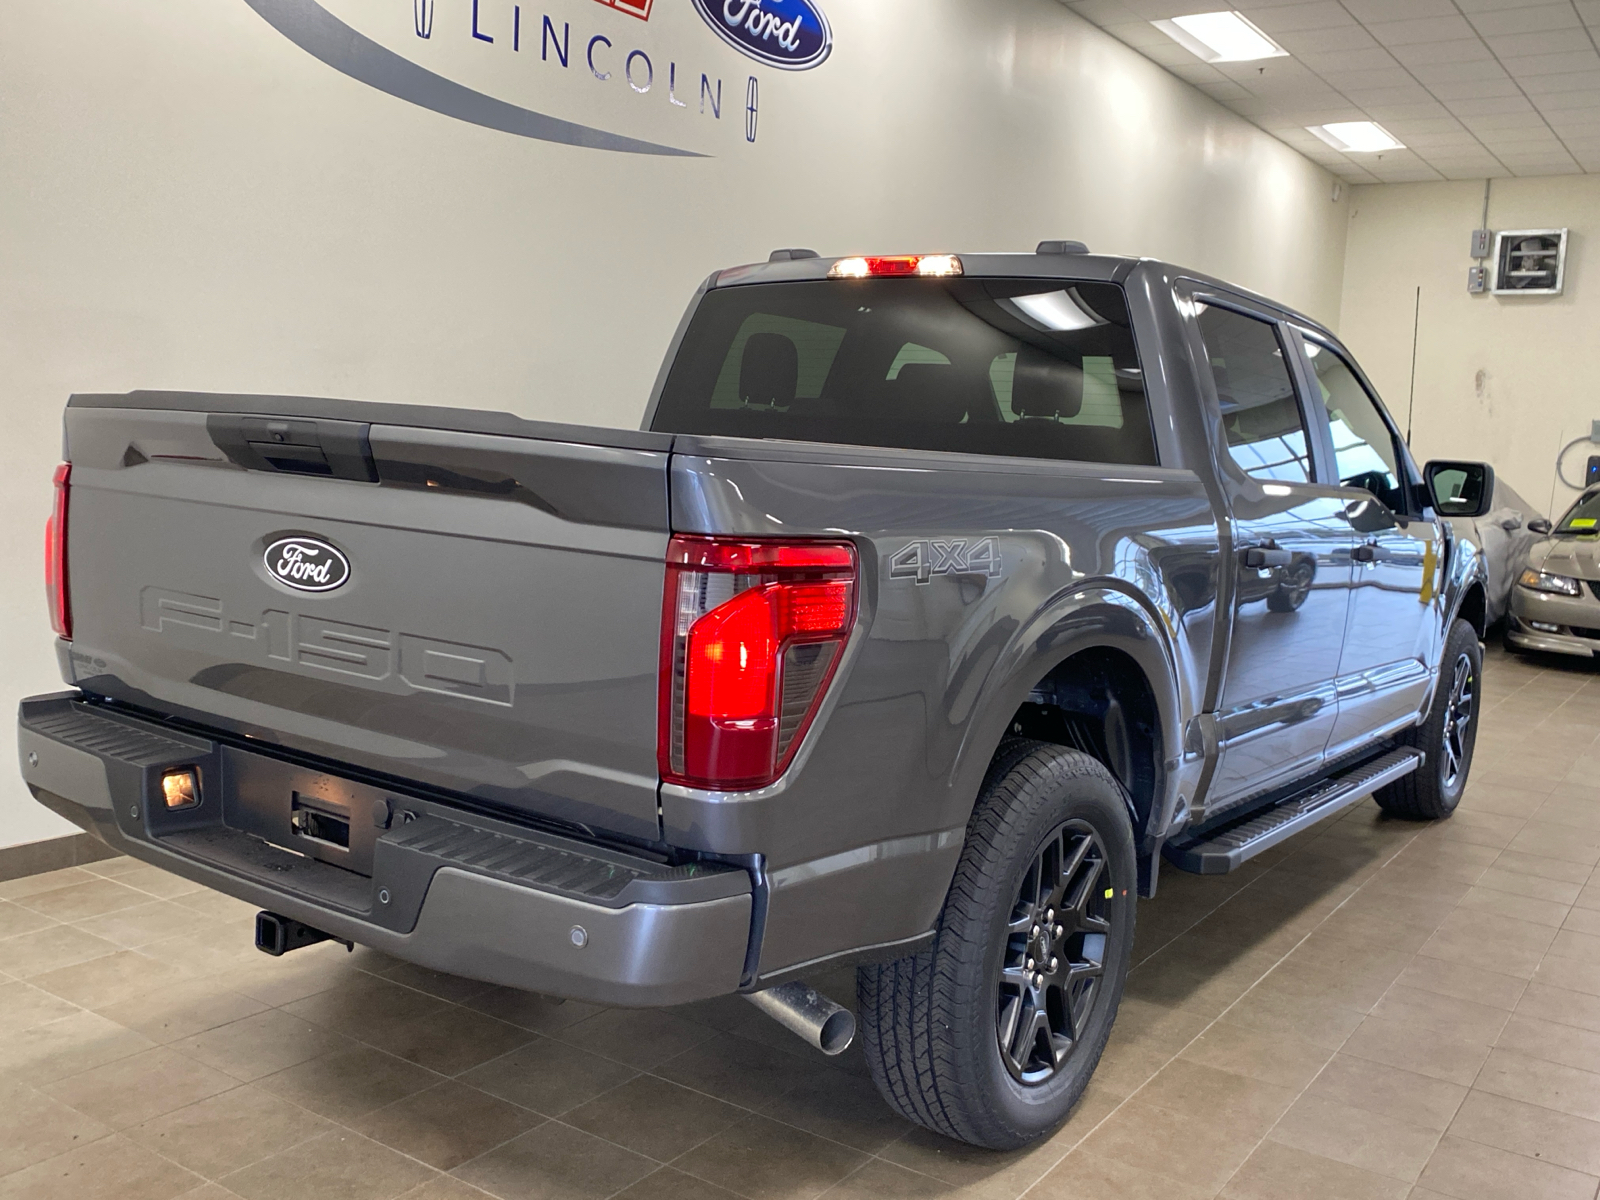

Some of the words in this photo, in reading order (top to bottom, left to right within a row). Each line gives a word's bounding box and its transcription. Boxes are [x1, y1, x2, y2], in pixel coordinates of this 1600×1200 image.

[472, 0, 722, 119] LINCOLN
[277, 544, 332, 583] Ford
[140, 585, 514, 707] F-150
